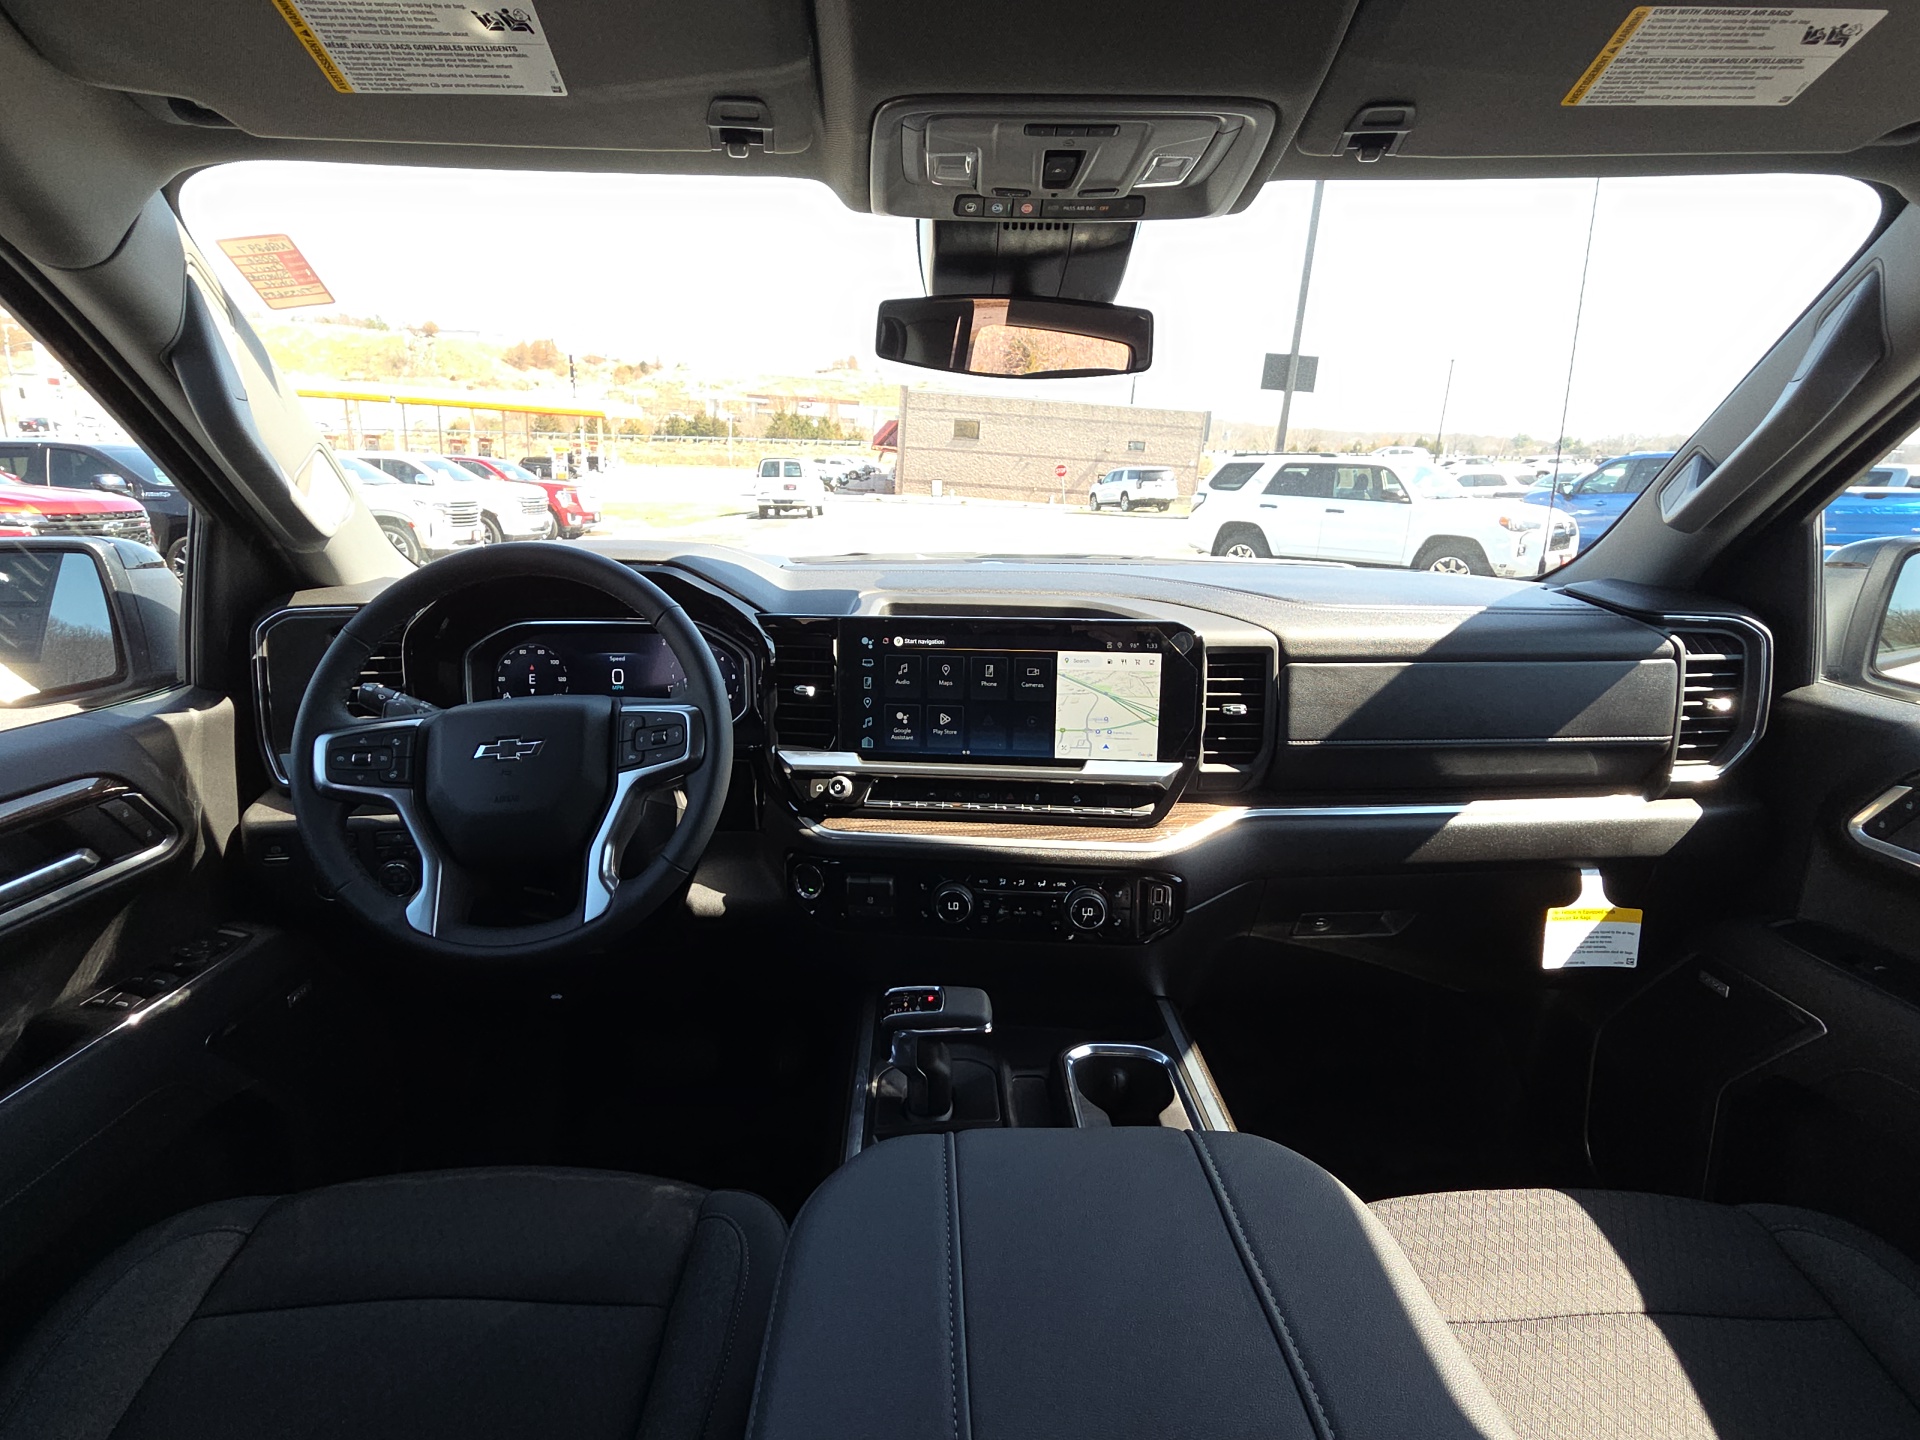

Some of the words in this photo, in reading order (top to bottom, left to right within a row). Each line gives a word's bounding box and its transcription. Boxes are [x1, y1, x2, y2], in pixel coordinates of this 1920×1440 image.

[323, 40, 350, 49] MÊME
[412, 44, 464, 52] GONFLABLES
[1615, 56, 1639, 64] MÊME
[528, 673, 536, 685] E
[611, 668, 624, 685] 0
